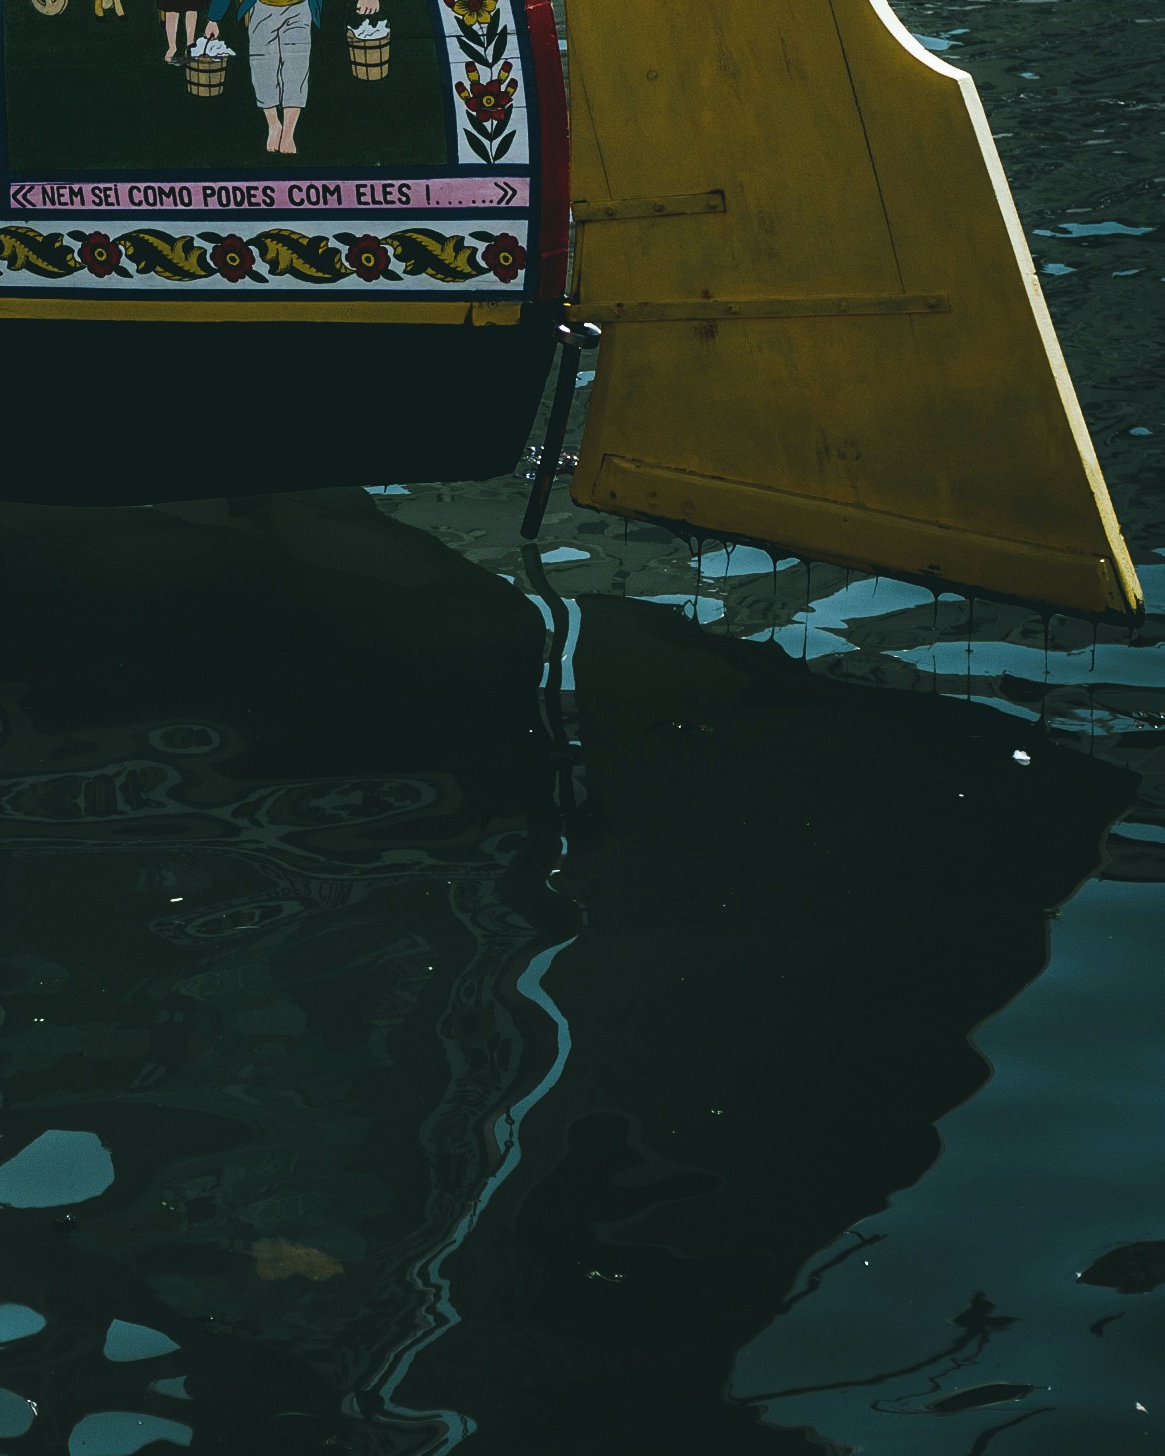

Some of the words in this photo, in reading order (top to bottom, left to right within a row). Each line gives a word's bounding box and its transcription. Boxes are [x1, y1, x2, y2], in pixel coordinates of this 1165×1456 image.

[128, 185, 192, 207] COMO
[202, 185, 276, 207] PODES
[288, 183, 342, 206] COM
[355, 183, 411, 205] ELES
